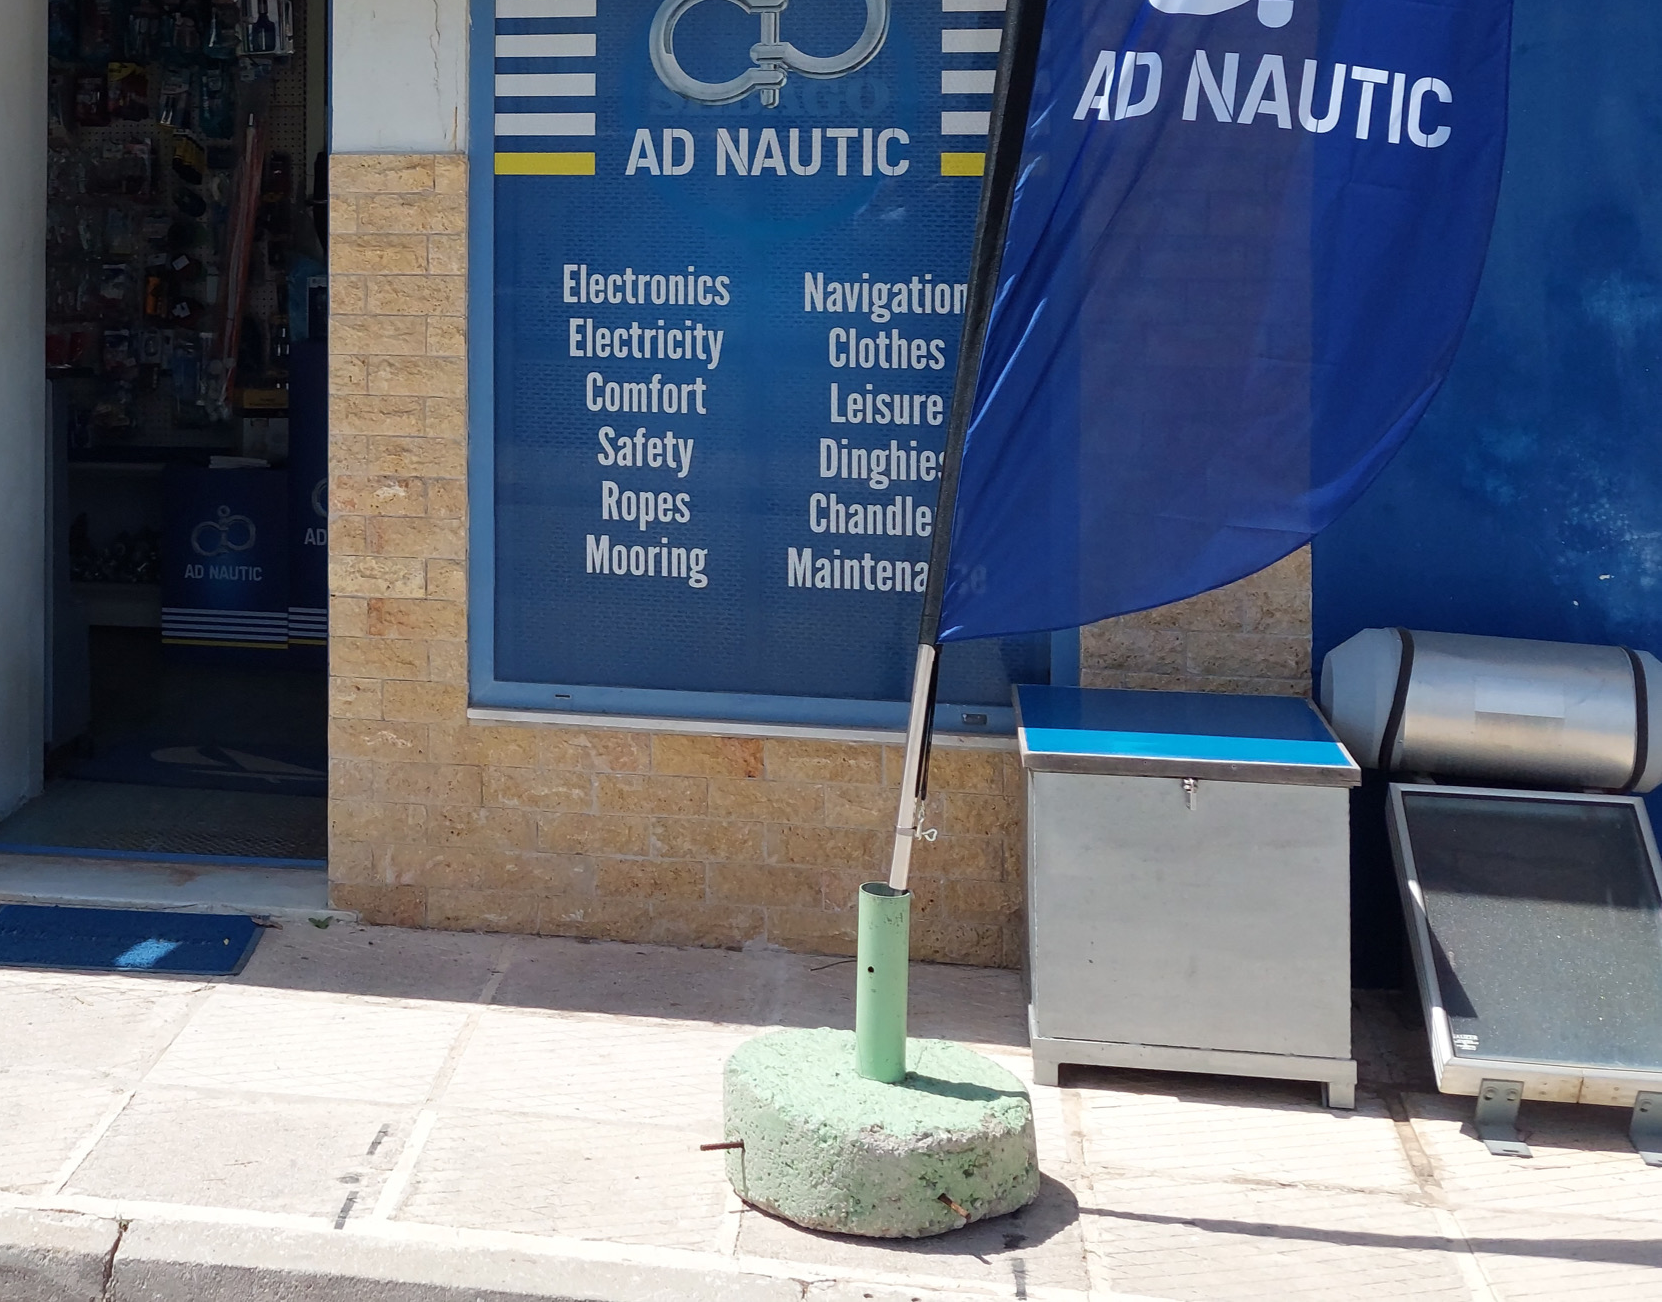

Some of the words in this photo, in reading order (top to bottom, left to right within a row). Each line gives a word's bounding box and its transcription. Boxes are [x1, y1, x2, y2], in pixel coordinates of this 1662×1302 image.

[1072, 49, 1163, 122] AD
[1181, 49, 1453, 148] NAUTIC
[624, 128, 695, 176] AD
[716, 127, 910, 177] NAUTIC
[563, 264, 731, 306] Electronics
[569, 317, 725, 371] Electricity
[828, 327, 946, 370] Clothes
[586, 371, 707, 415] Comfort
[830, 382, 944, 426] Leisure
[597, 425, 694, 478] Safety
[601, 480, 691, 530] Ropes
[809, 492, 937, 537] Chandle
[304, 528, 328, 546] AD
[185, 564, 204, 579] AD
[209, 565, 262, 581] NAUTIC
[586, 534, 709, 589] Mooring
